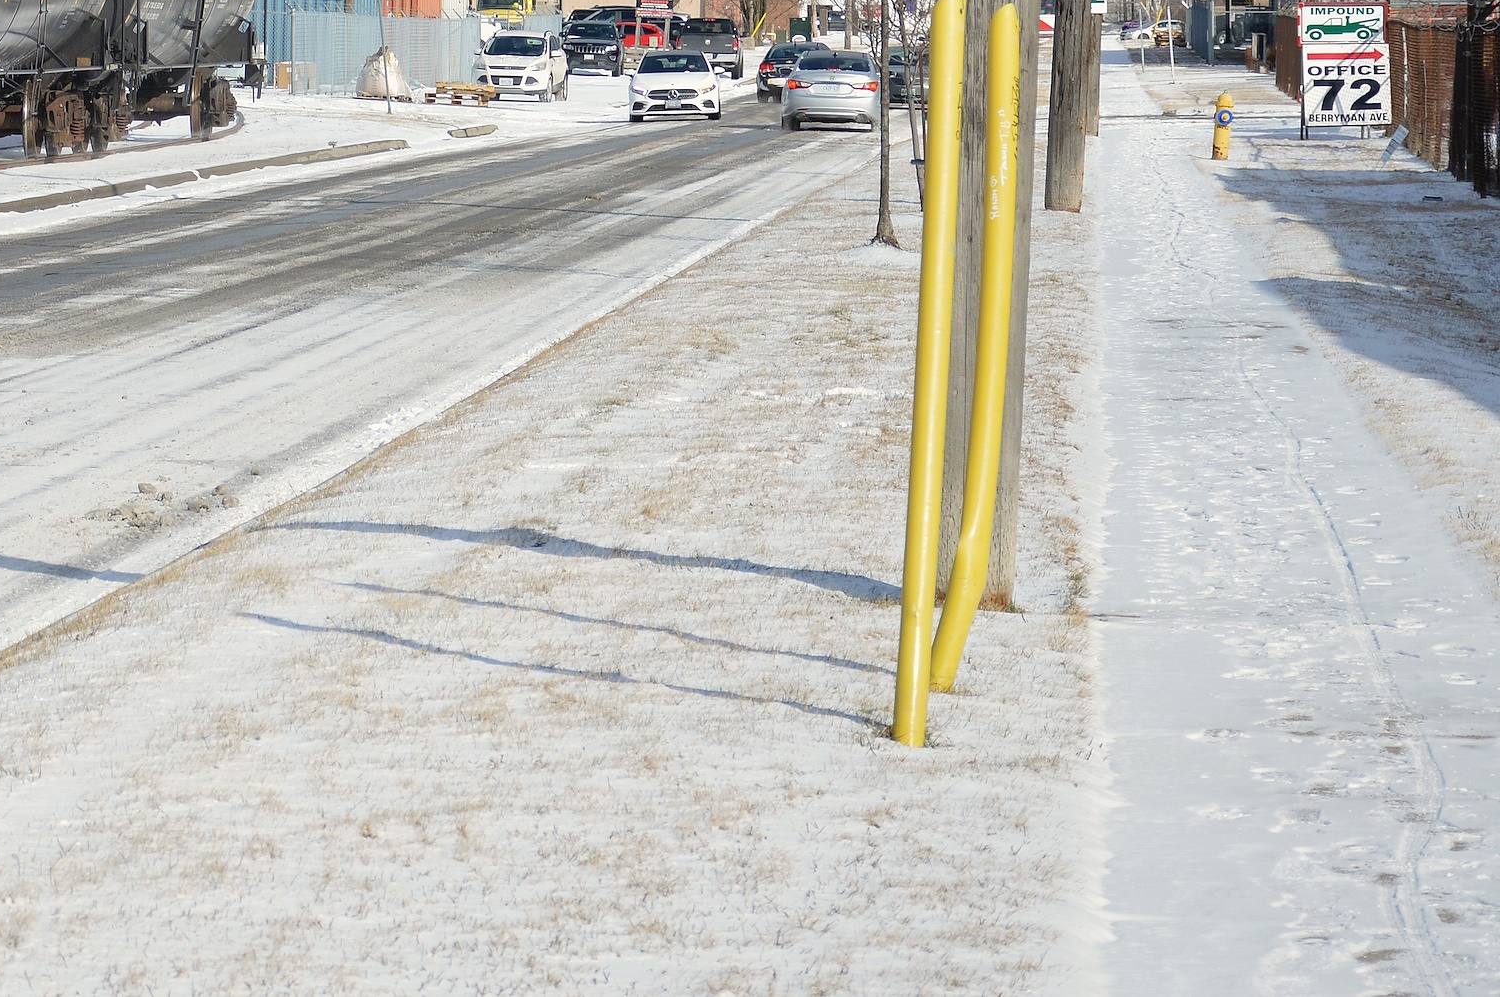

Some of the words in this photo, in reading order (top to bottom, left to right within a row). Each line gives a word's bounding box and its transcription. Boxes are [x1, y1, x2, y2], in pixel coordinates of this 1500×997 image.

[1310, 7, 1375, 16] IMPOUND
[1307, 65, 1386, 76] OFFICE
[1313, 78, 1382, 111] 72
[1309, 113, 1366, 123] BERRYMAN
[1369, 112, 1388, 122] AVE
